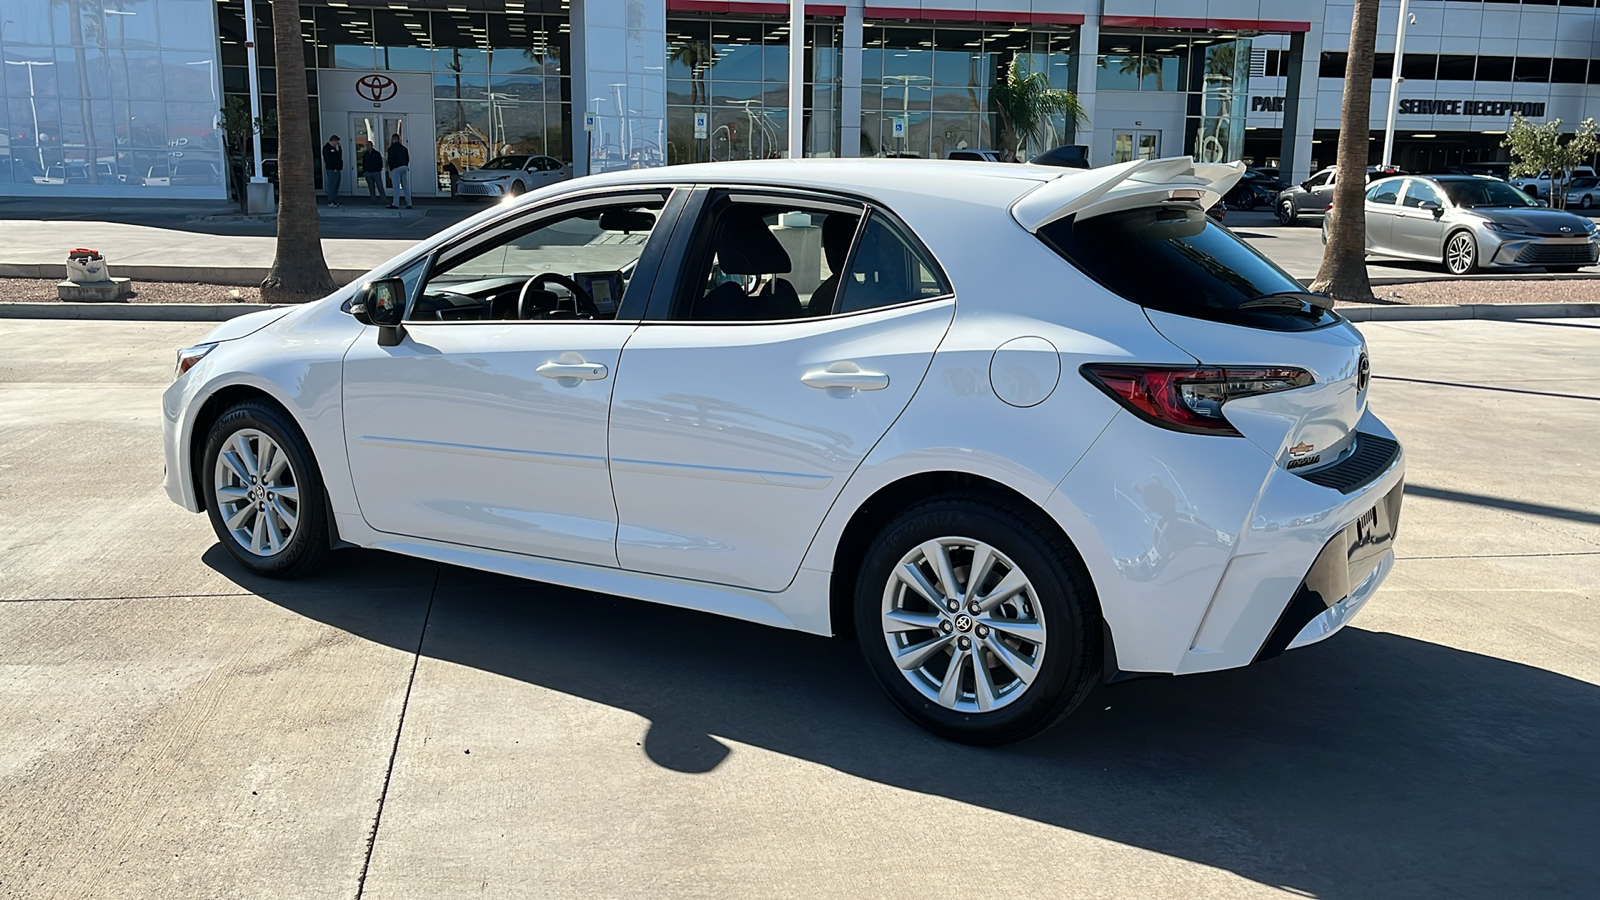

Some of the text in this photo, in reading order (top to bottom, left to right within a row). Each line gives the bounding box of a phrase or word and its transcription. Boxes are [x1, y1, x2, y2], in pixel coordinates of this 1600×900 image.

[1251, 96, 1285, 112] PAR
[1399, 99, 1545, 117] SERVICE RECEPTION
